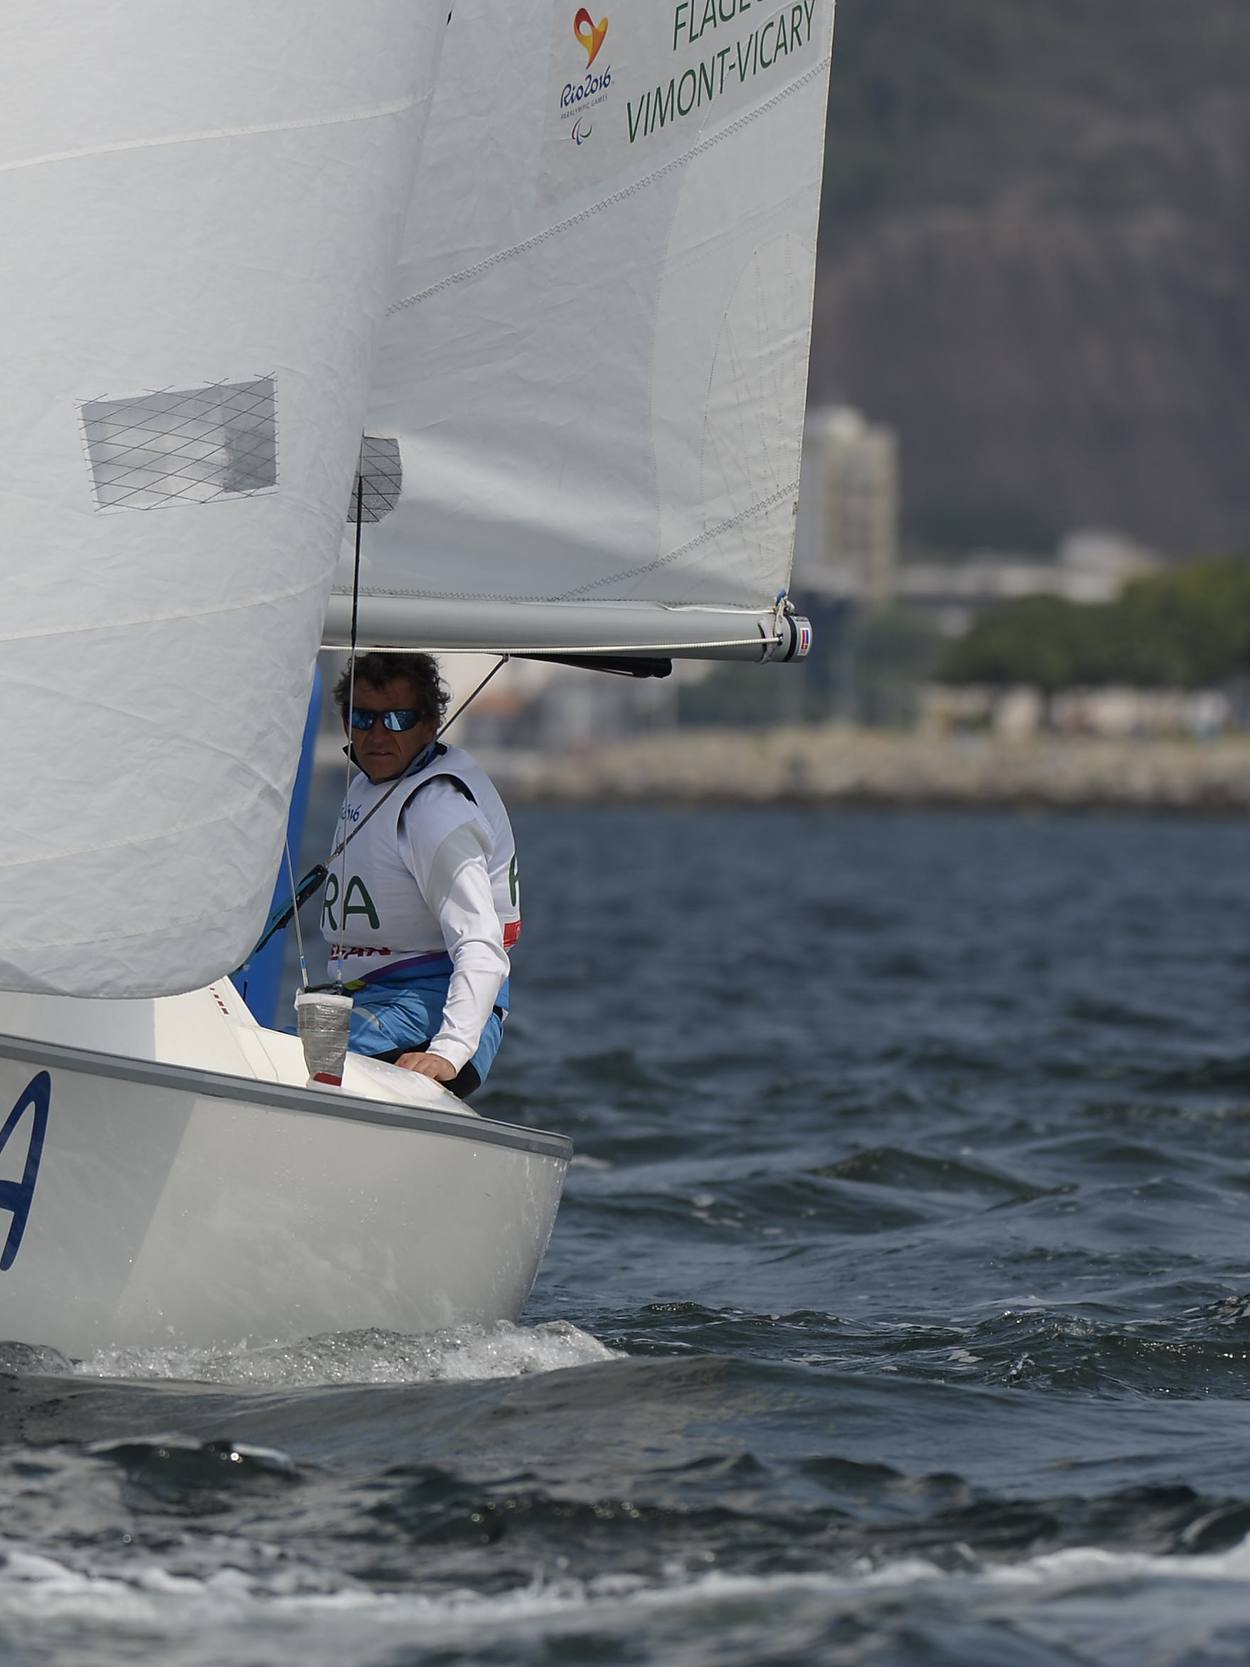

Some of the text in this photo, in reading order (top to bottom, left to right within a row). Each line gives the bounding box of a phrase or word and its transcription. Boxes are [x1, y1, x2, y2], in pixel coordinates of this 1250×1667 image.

[560, 65, 612, 109] Rio2016
[626, 0, 816, 144] VIMONT-VICARY
[321, 872, 381, 931] RA
